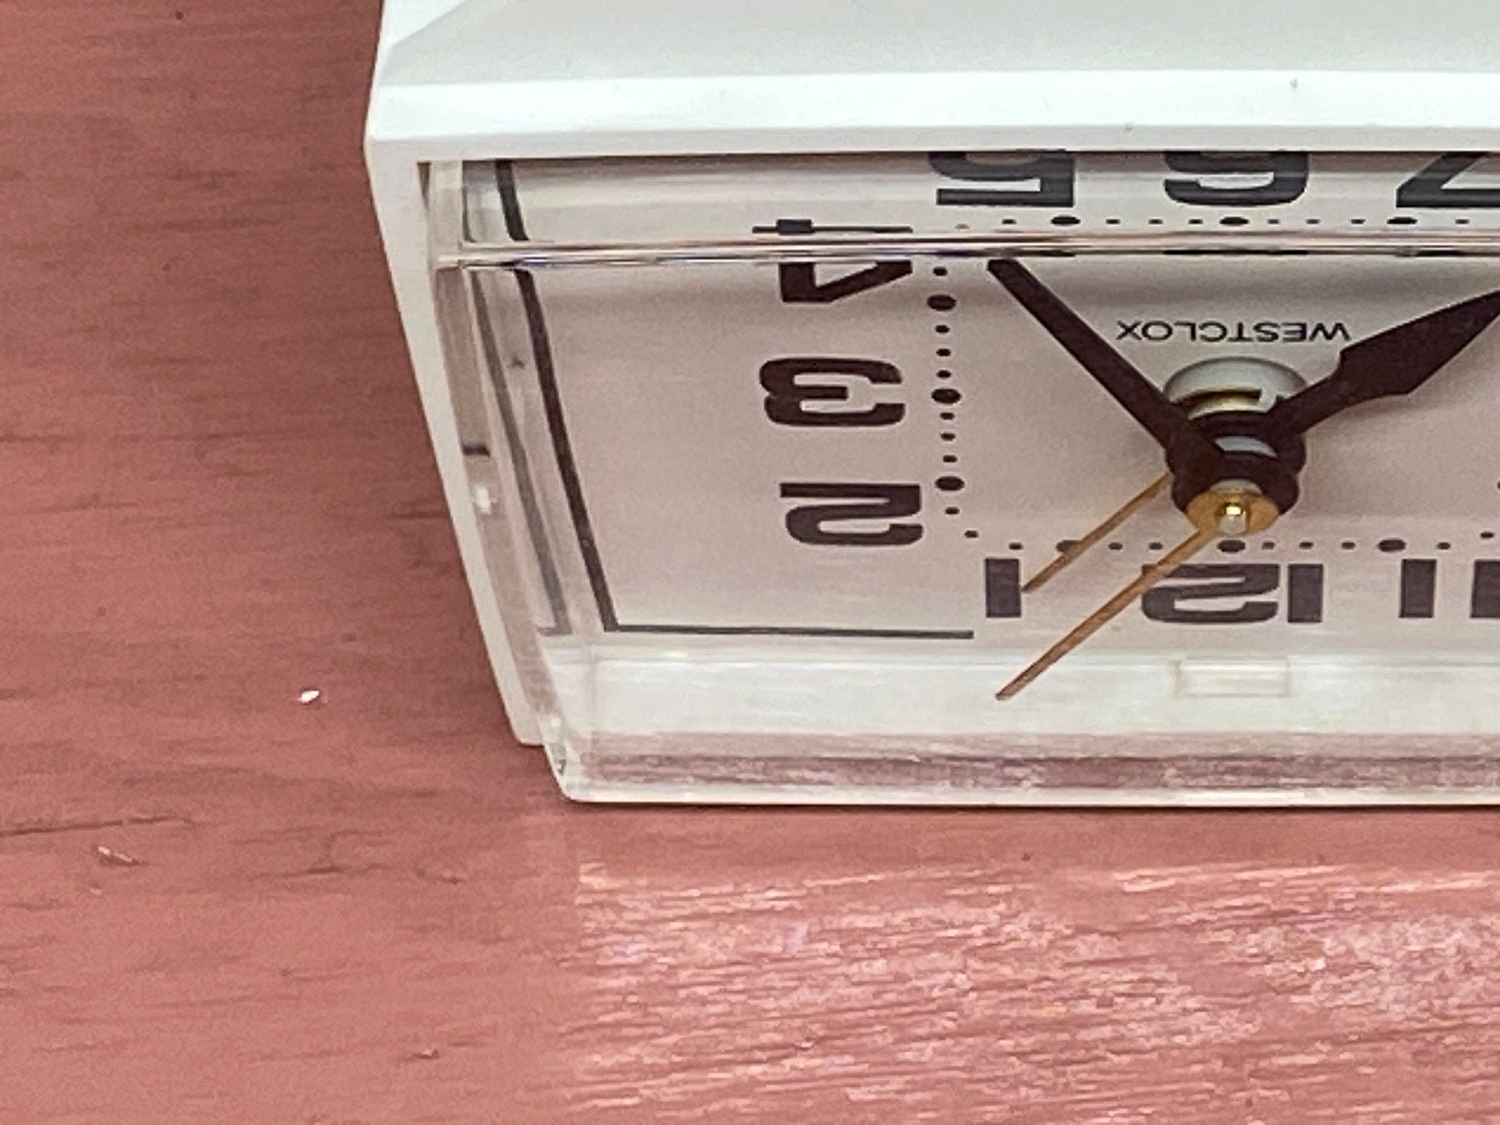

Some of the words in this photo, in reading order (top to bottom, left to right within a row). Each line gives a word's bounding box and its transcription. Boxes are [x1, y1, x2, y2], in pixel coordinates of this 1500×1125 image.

[752, 219, 912, 303] 4
[1116, 320, 1351, 342] WESTCLOX
[759, 357, 905, 426] 3
[780, 482, 923, 546] 2
[985, 558, 1021, 618] 1
[1141, 563, 1324, 624] 12
